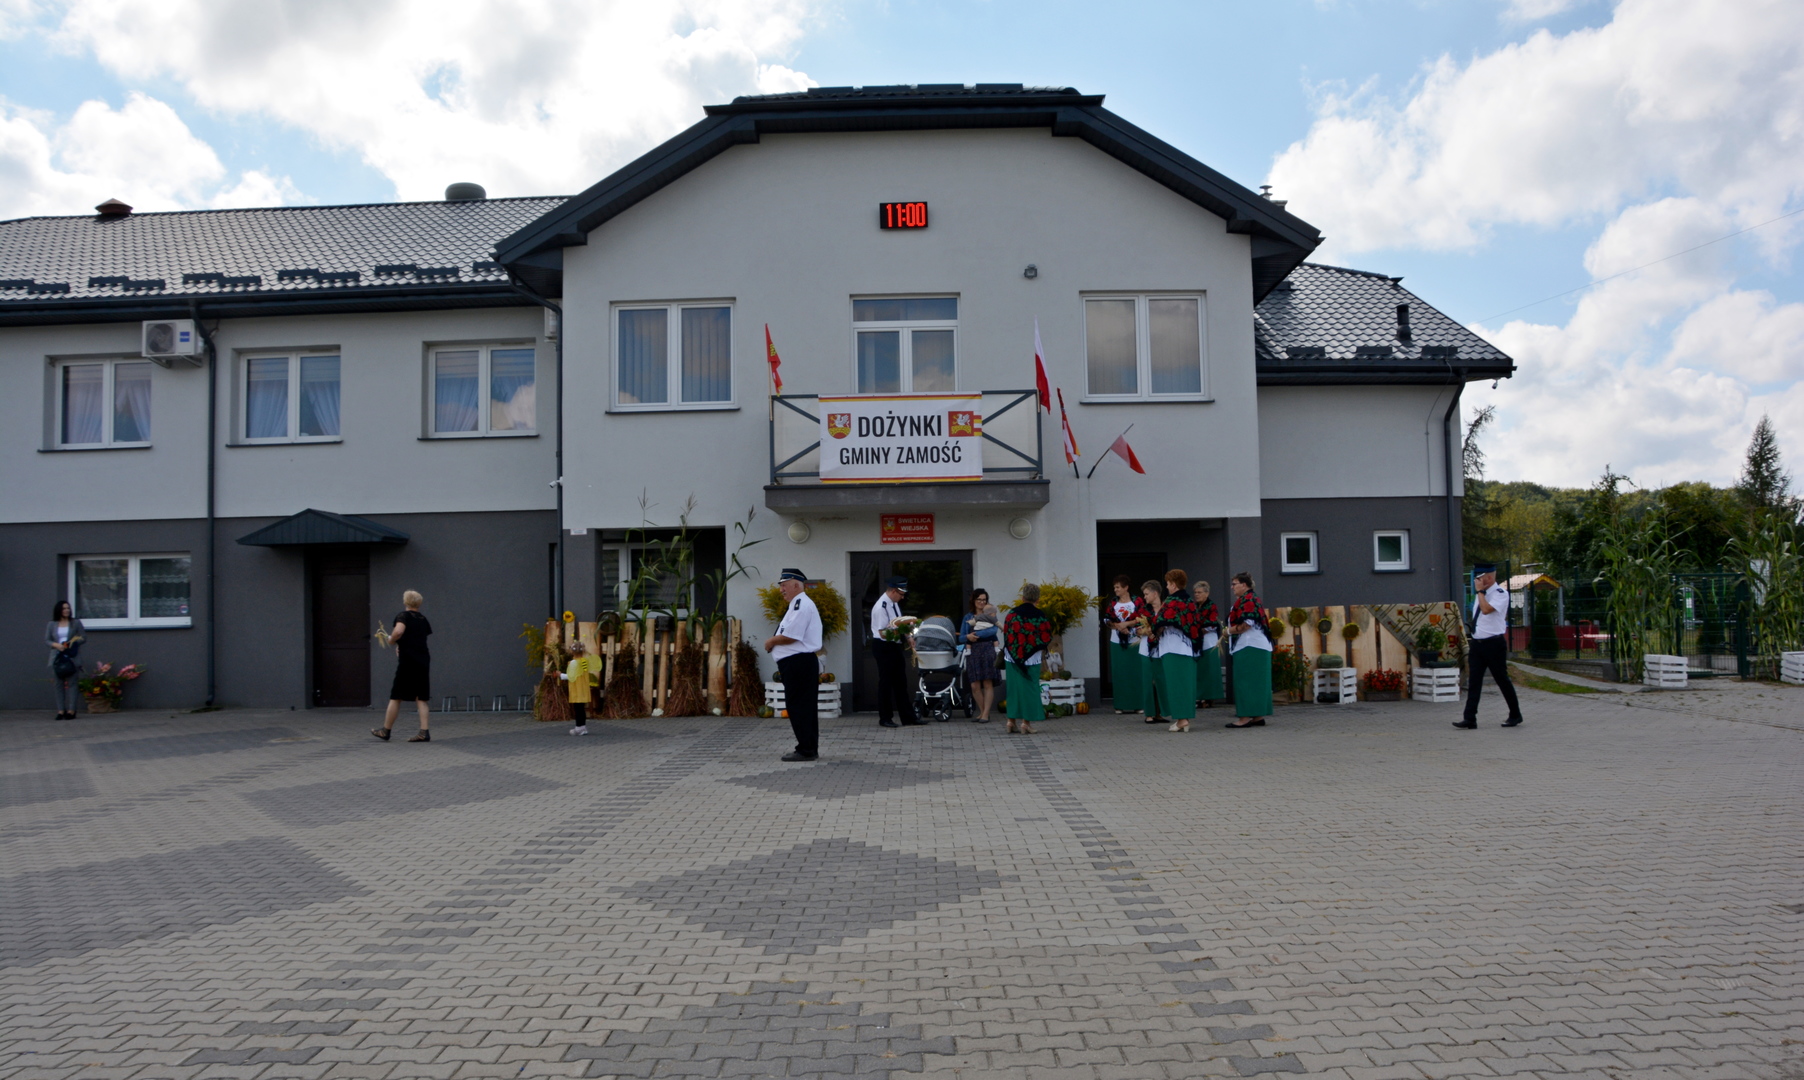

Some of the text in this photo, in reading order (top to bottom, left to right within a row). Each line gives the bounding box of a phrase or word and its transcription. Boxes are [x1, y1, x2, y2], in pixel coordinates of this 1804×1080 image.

[886, 202, 926, 227] 11:00
[858, 410, 942, 438] DOŻYNKI
[839, 440, 962, 465] GMINY ZAMOŚĆ
